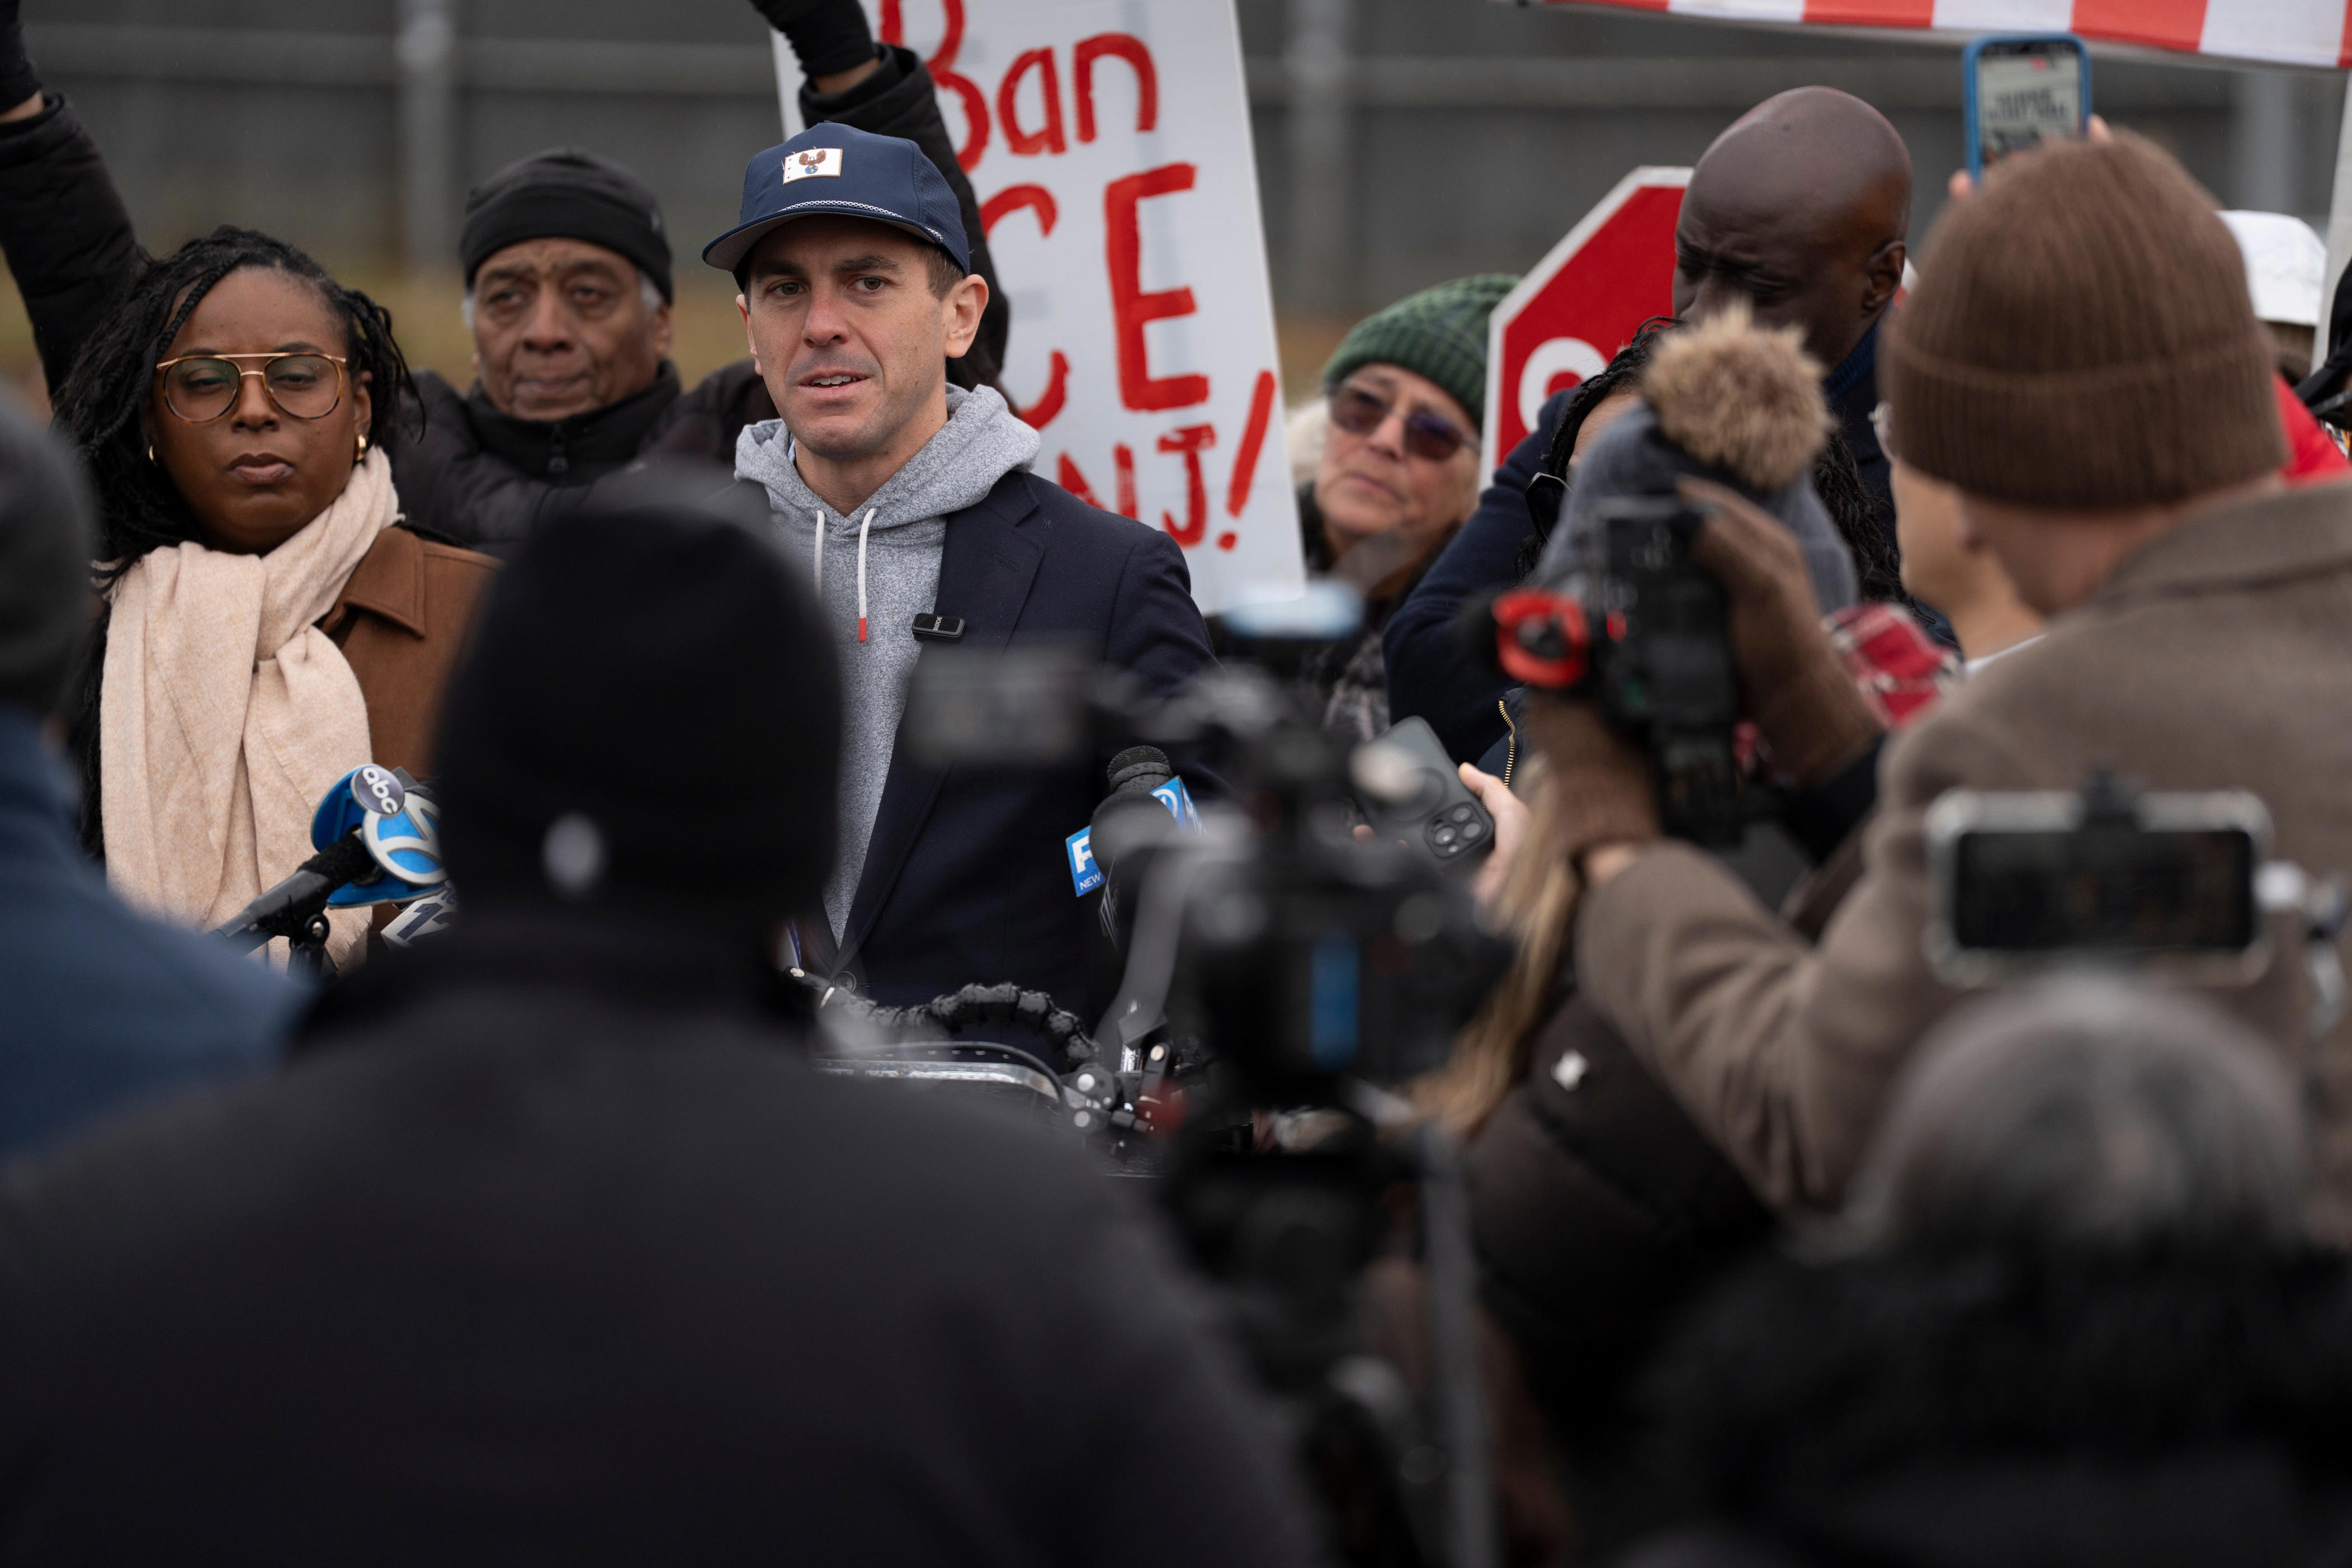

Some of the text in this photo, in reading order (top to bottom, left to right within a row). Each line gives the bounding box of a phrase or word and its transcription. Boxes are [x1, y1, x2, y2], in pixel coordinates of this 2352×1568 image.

[879, 0, 1159, 174] Ban
[362, 767, 399, 815] abc
[1079, 872, 1101, 890] NEW
